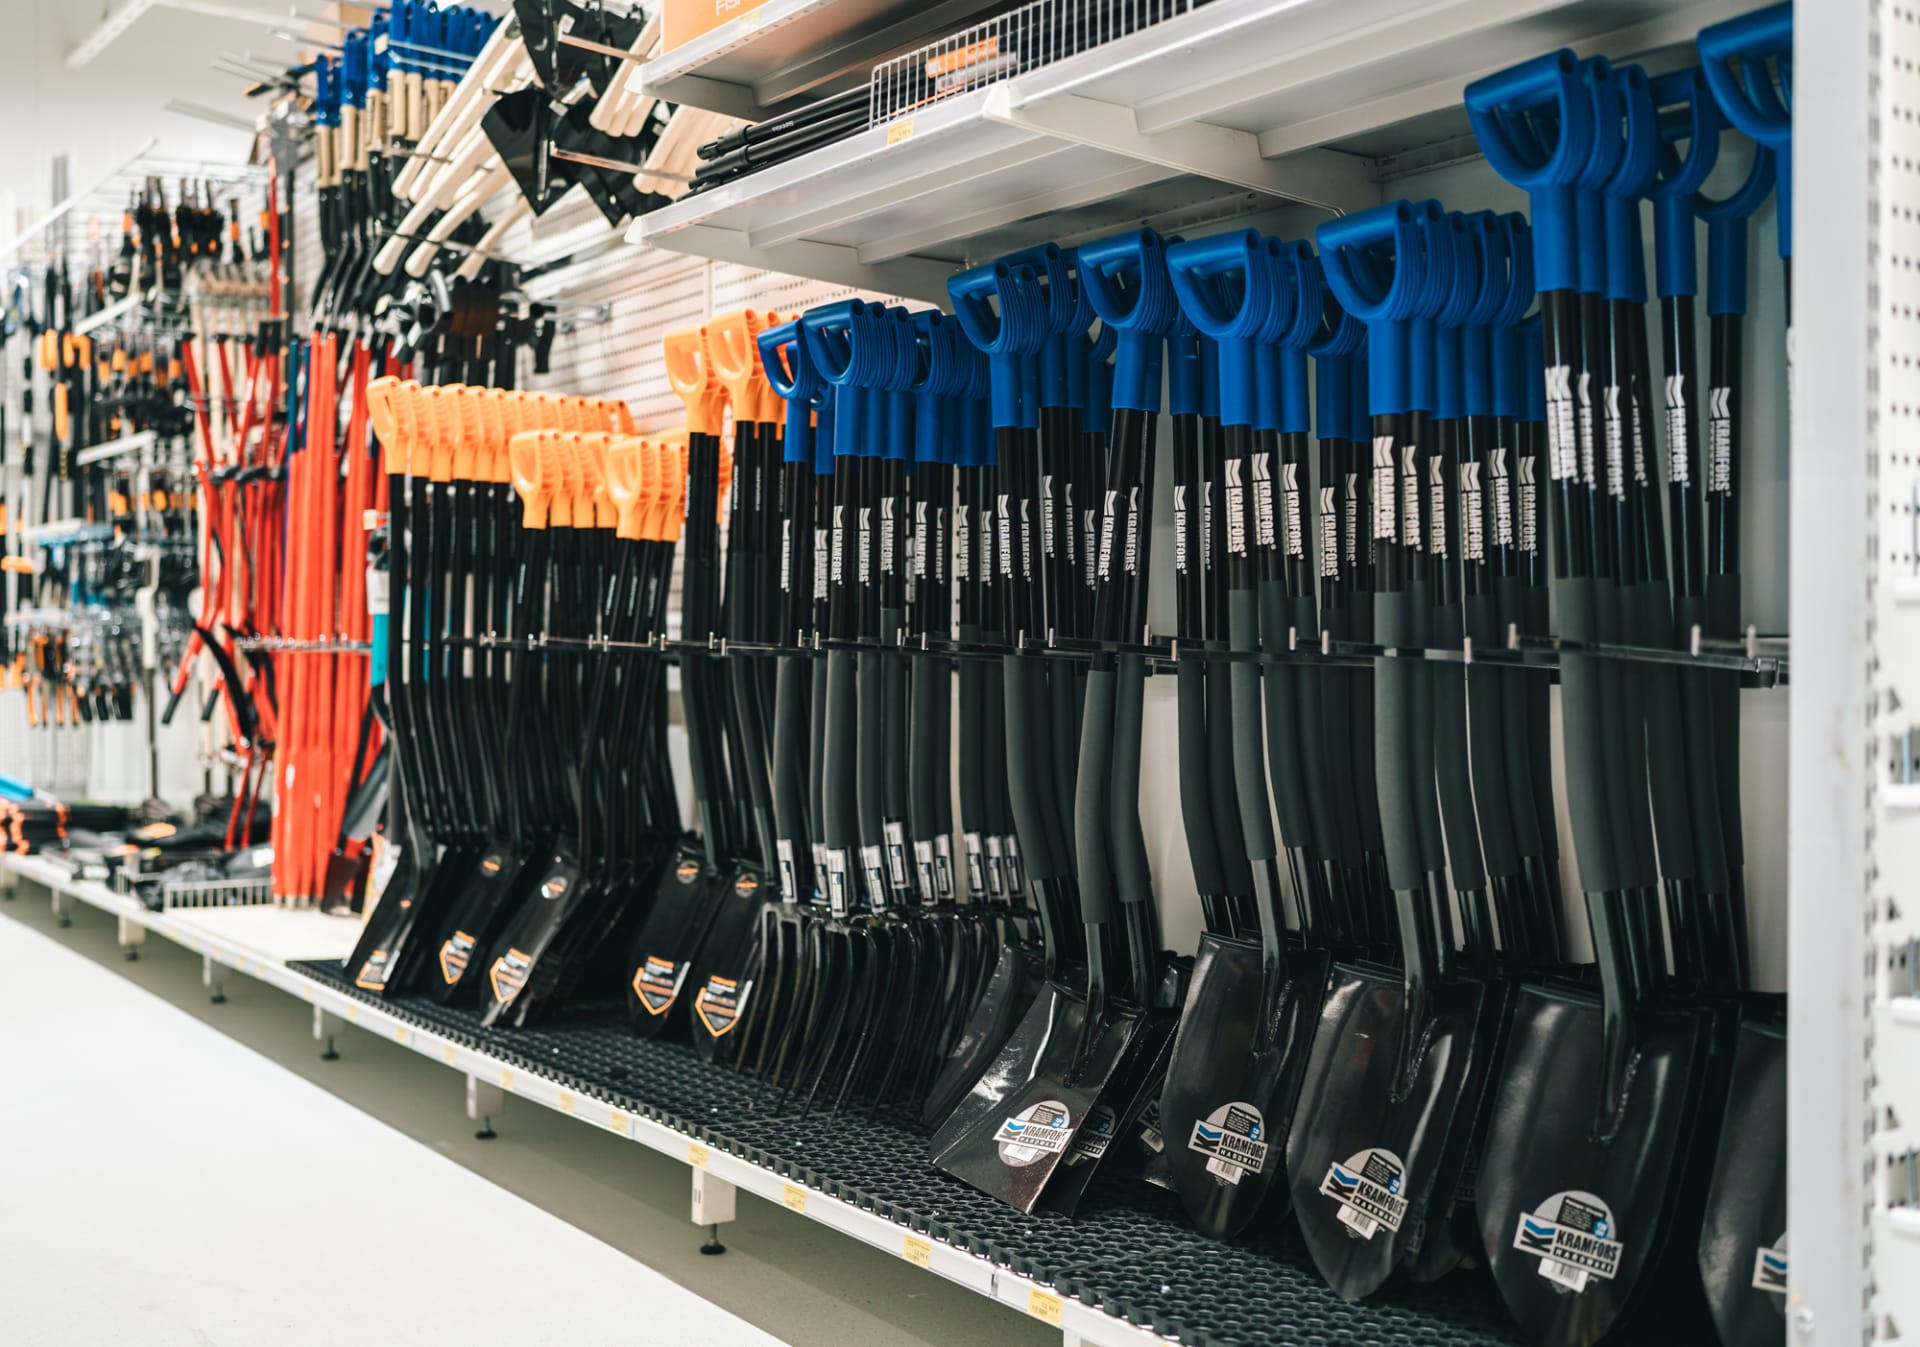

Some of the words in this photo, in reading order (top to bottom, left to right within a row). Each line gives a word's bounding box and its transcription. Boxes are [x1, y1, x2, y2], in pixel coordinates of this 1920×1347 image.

[1714, 419, 1730, 491] KRAMFORS
[1175, 512, 1186, 569] KRAMFORS
[1230, 488, 1245, 552] KRAMFORS
[1259, 481, 1274, 545] KRAMFORS
[1287, 492, 1302, 554] KRAMFORS
[1468, 492, 1483, 559] KRAMFORS
[1098, 517, 1114, 576] KRAMFORS
[1324, 514, 1338, 576] KRAMFORS
[1221, 1133, 1265, 1159] KRAMFORS
[1356, 1180, 1402, 1217] KRAMFORS
[1556, 1229, 1619, 1262] KRAMFORS
